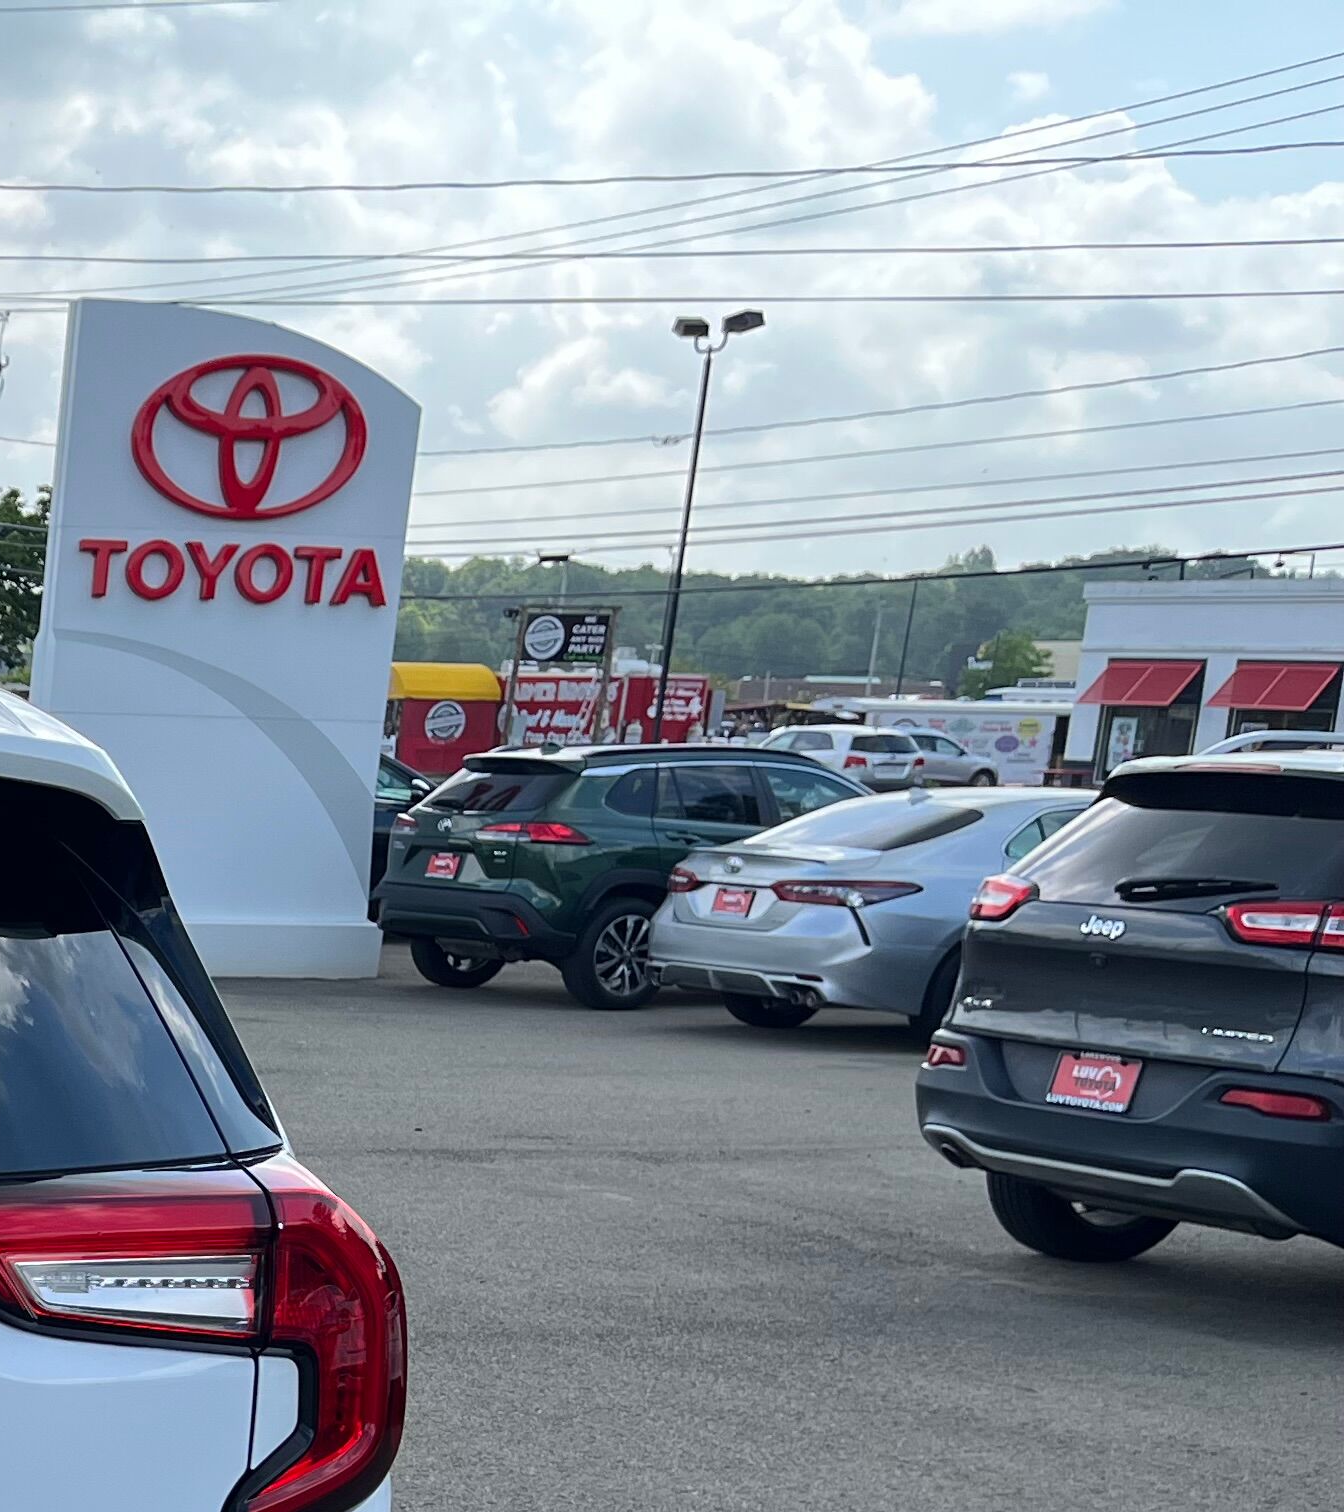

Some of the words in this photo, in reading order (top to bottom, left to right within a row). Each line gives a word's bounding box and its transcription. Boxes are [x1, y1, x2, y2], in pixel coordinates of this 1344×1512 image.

[78, 538, 387, 608] TOYOTA
[1080, 914, 1127, 941] Jeep
[1072, 1065, 1099, 1080] LUV
[1074, 1078, 1116, 1091] TOYOTA
[1045, 1093, 1125, 1113] LUVTOYOTA.COM
